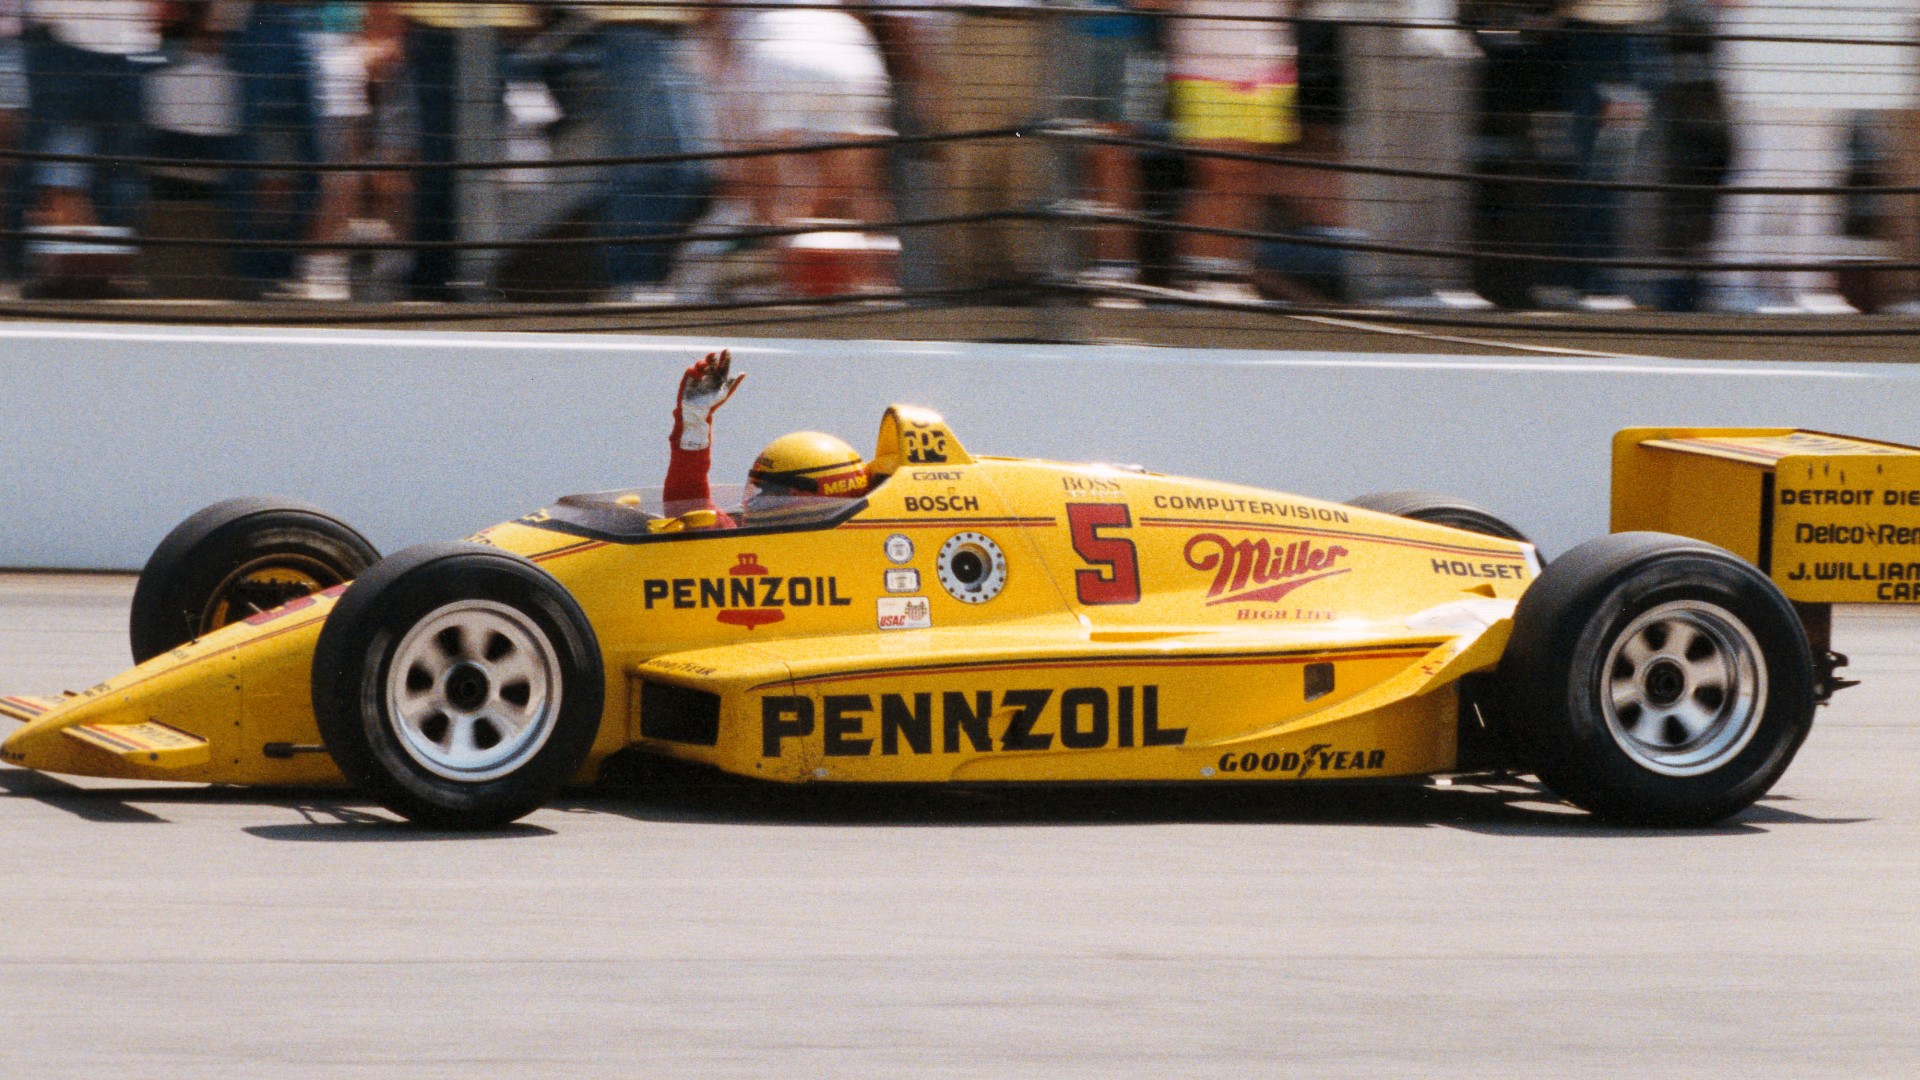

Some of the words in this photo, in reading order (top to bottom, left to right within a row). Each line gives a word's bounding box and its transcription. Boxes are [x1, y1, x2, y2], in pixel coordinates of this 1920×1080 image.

[904, 430, 947, 463] PPG
[1062, 477, 1121, 490] BOSS
[1780, 489, 1874, 505] DETROIT
[1883, 490, 1920, 506] DIE
[904, 495, 979, 511] BOSCH
[1153, 494, 1350, 524] COMPUTERVISION
[1065, 502, 1142, 606] 5
[1183, 532, 1350, 598] Miller
[1431, 558, 1524, 580] HOLSET
[643, 576, 852, 609] PENNZOIL
[880, 615, 906, 627] USAC
[1237, 608, 1288, 620] HIGH
[761, 684, 1189, 758] PENNZOIL
[1218, 744, 1386, 777] GOODYEAR
